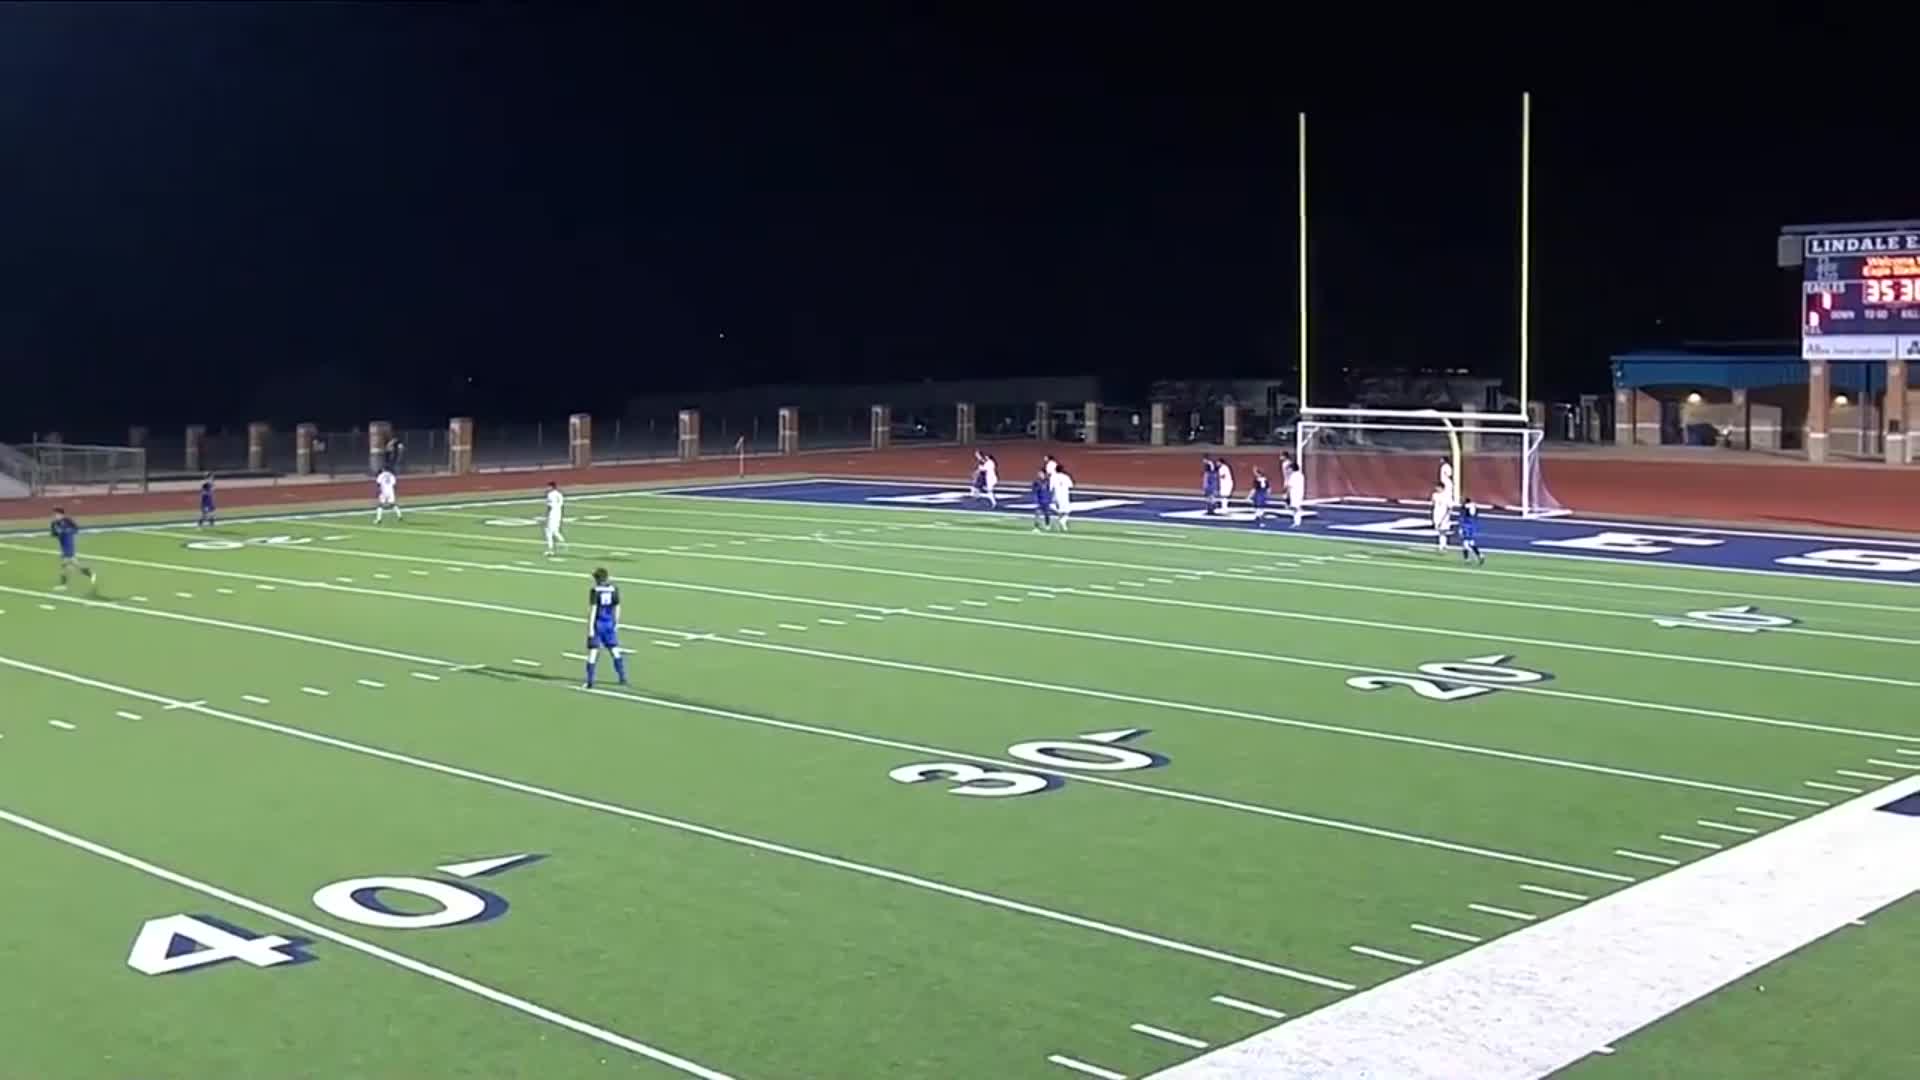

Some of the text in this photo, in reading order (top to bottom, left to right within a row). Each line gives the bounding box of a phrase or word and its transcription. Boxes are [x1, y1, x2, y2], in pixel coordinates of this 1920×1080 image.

[1812, 238, 1899, 252] LINDALE
[1345, 661, 1551, 701] 20
[888, 740, 1166, 797] 30
[127, 875, 508, 976] 40
